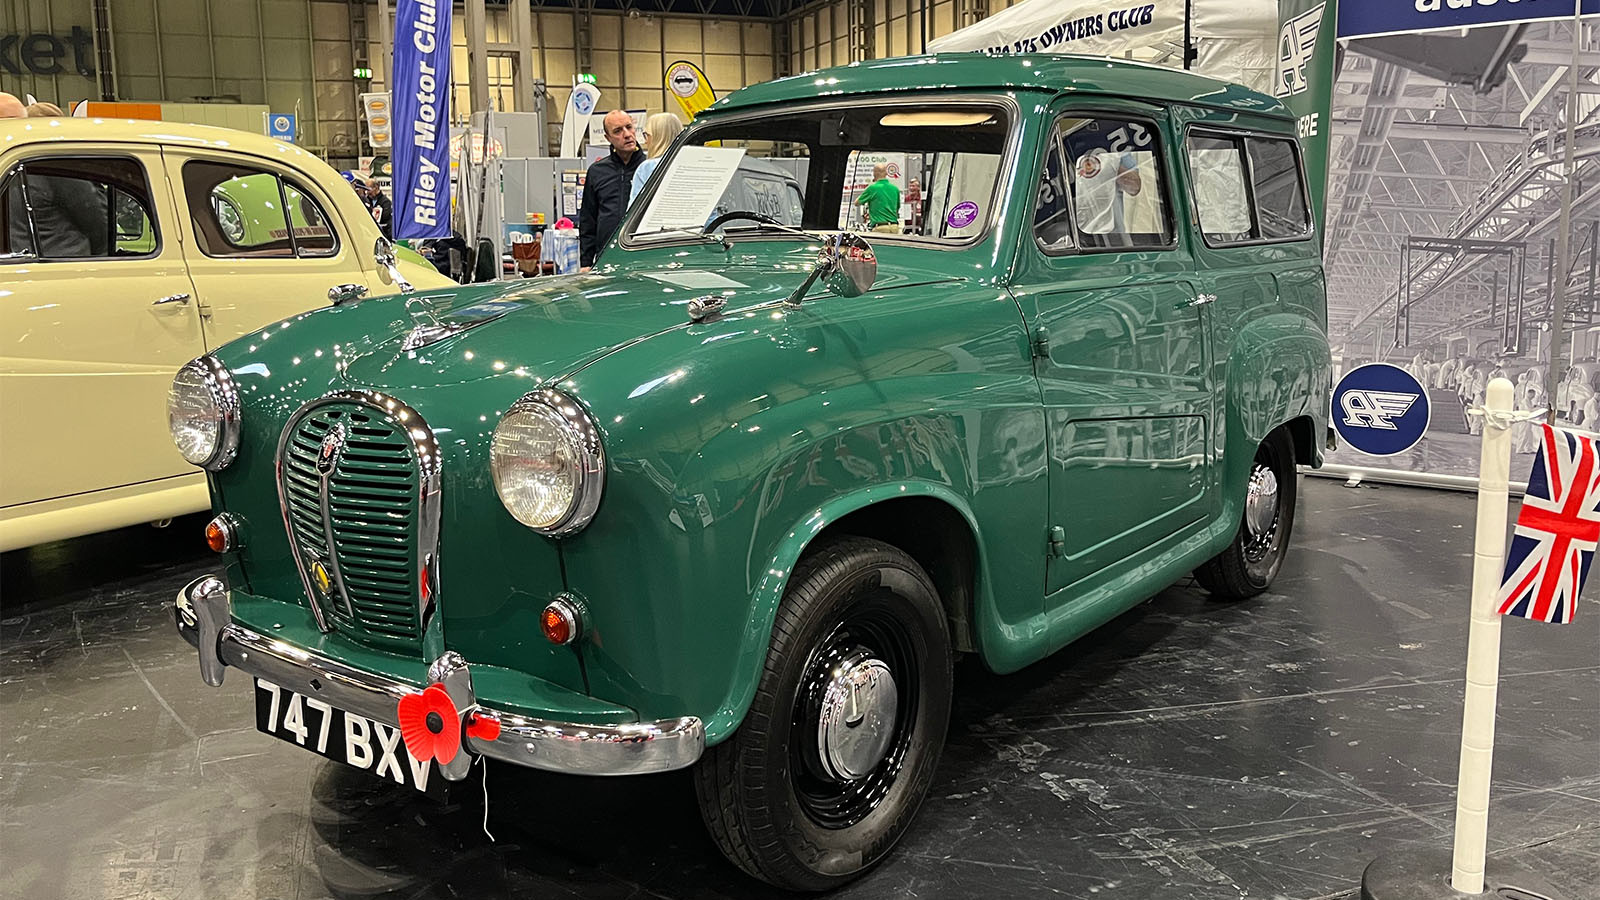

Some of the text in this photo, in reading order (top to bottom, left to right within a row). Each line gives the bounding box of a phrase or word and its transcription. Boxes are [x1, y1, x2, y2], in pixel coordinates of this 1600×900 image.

[1039, 14, 1103, 49] OWNERS
[1107, 4, 1155, 32] CLUB
[414, 60, 436, 151] Motor
[1297, 112, 1319, 139] ERE
[414, 156, 440, 227] Riley
[257, 678, 431, 793] 747 BXV
